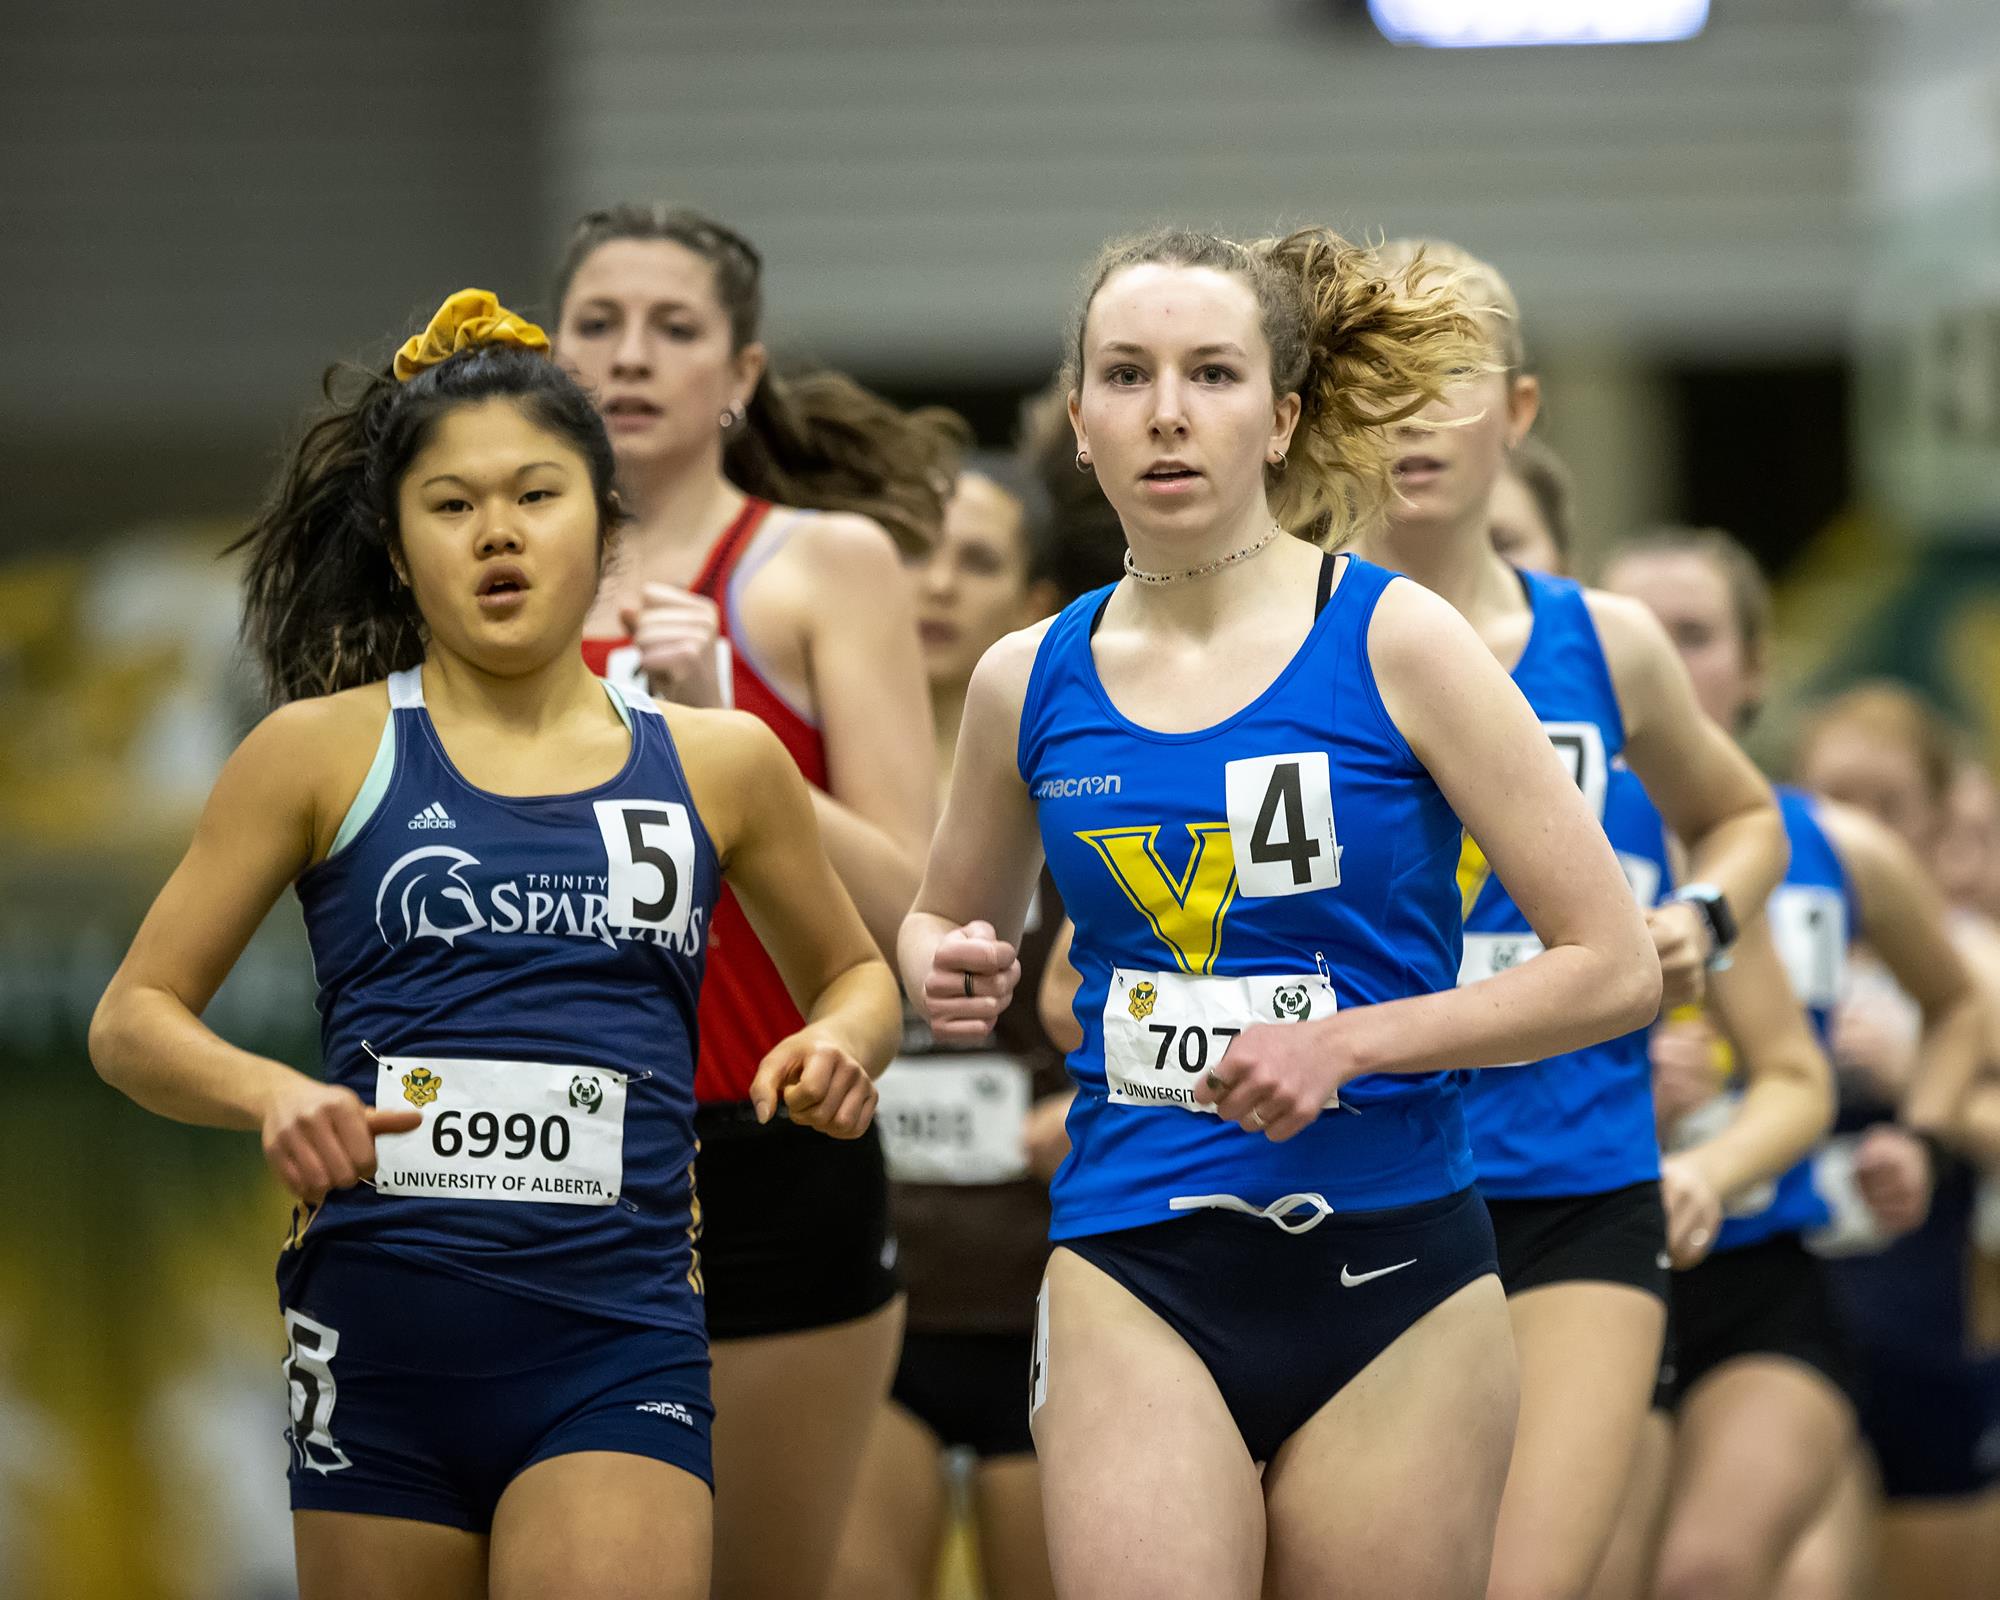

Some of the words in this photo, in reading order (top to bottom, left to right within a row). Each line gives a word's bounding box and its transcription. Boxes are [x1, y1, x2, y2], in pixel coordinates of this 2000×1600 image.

[408, 817, 456, 830] adidas
[1250, 762, 1321, 885] 4
[527, 873, 608, 892] TRINITY
[622, 808, 678, 923] 5
[490, 881, 703, 958] SPARS
[432, 1110, 570, 1163] 6990
[393, 1171, 497, 1191] UNIVERSITY
[502, 1175, 526, 1192] OF
[531, 1176, 603, 1197] ALBERTA
